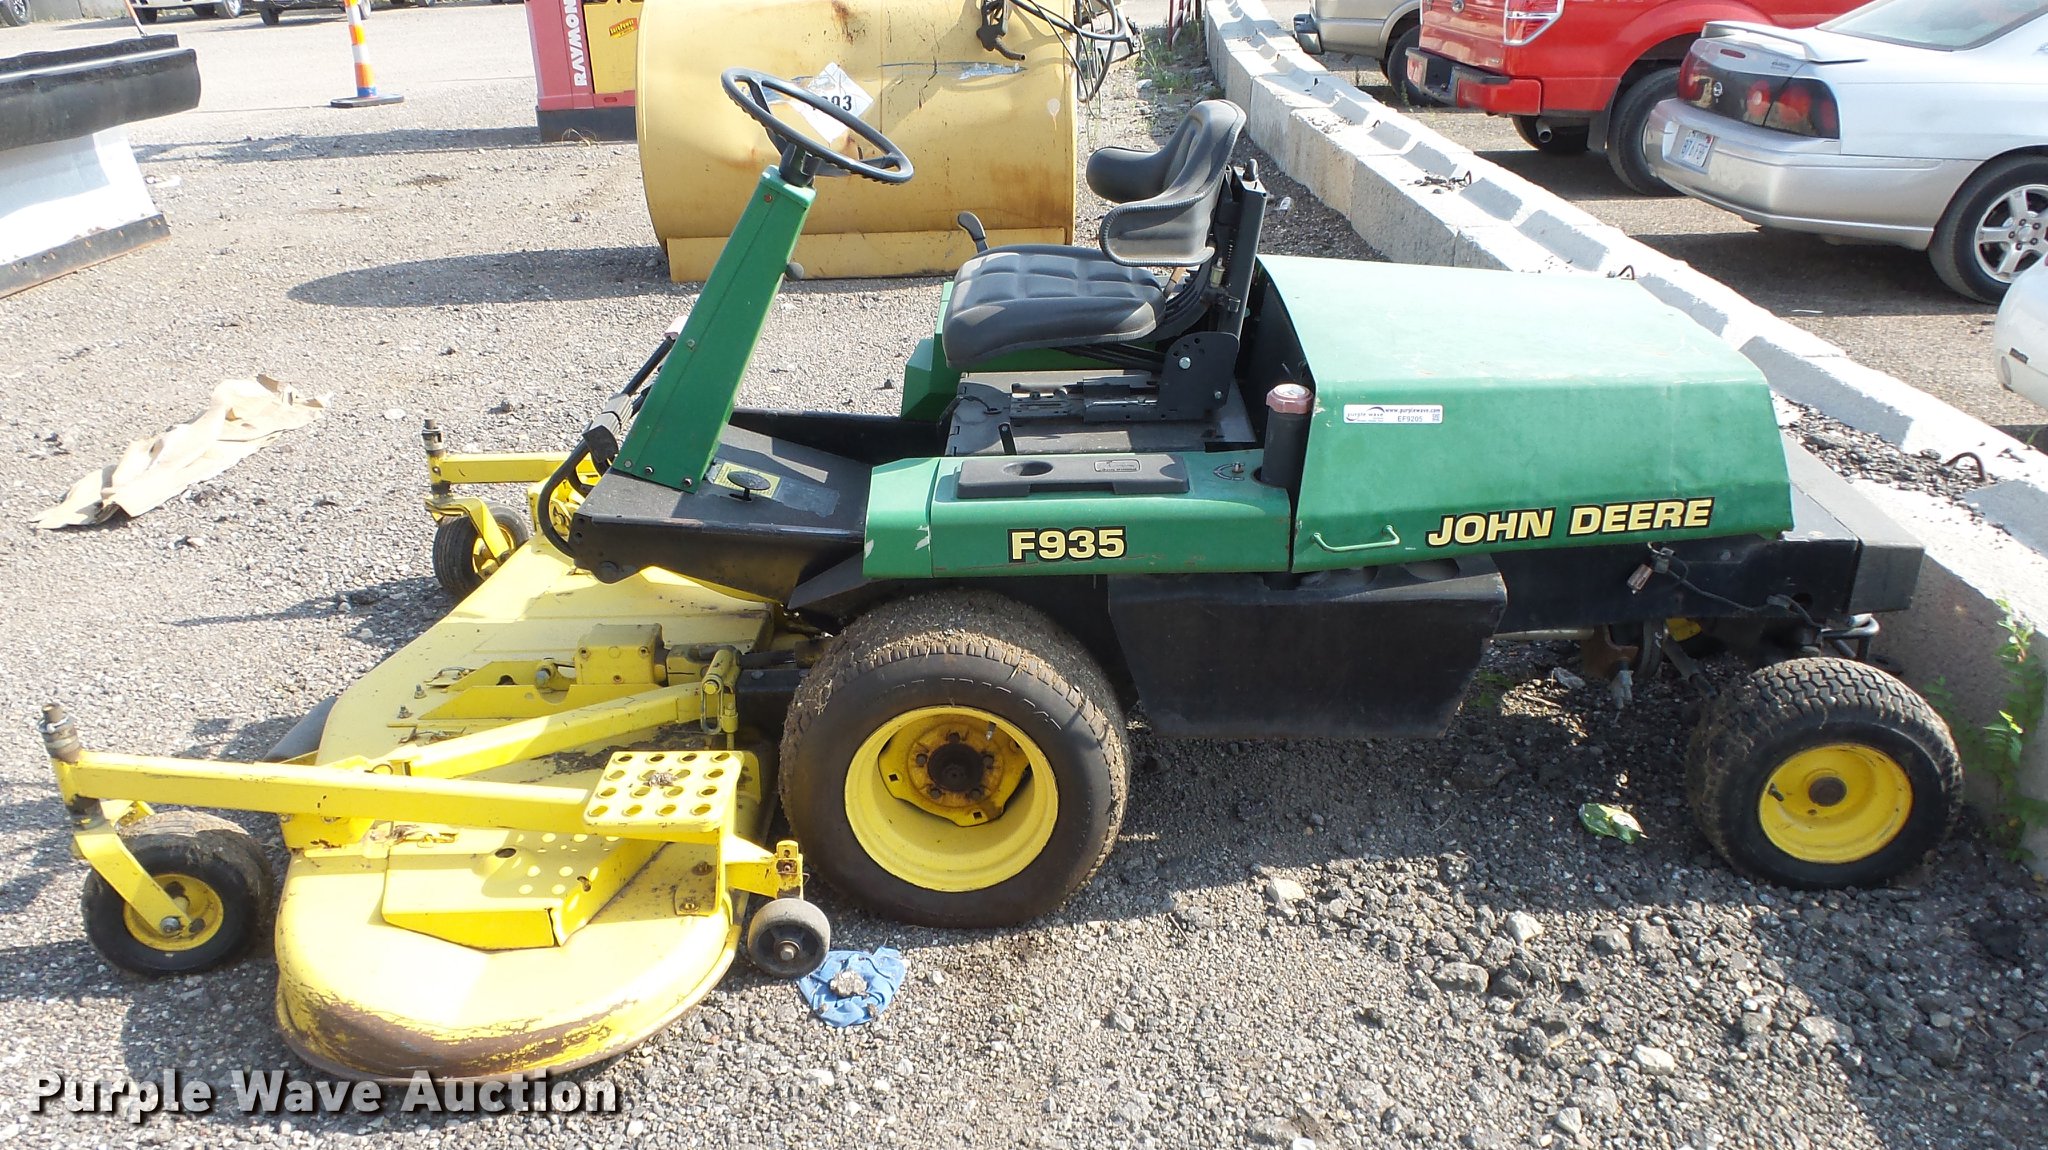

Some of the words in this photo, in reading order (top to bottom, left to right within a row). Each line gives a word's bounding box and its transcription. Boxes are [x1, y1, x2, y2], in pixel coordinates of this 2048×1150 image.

[1427, 508, 1555, 547] JOHN
[1568, 498, 1714, 536] DEERE
[1009, 528, 1126, 561] F935
